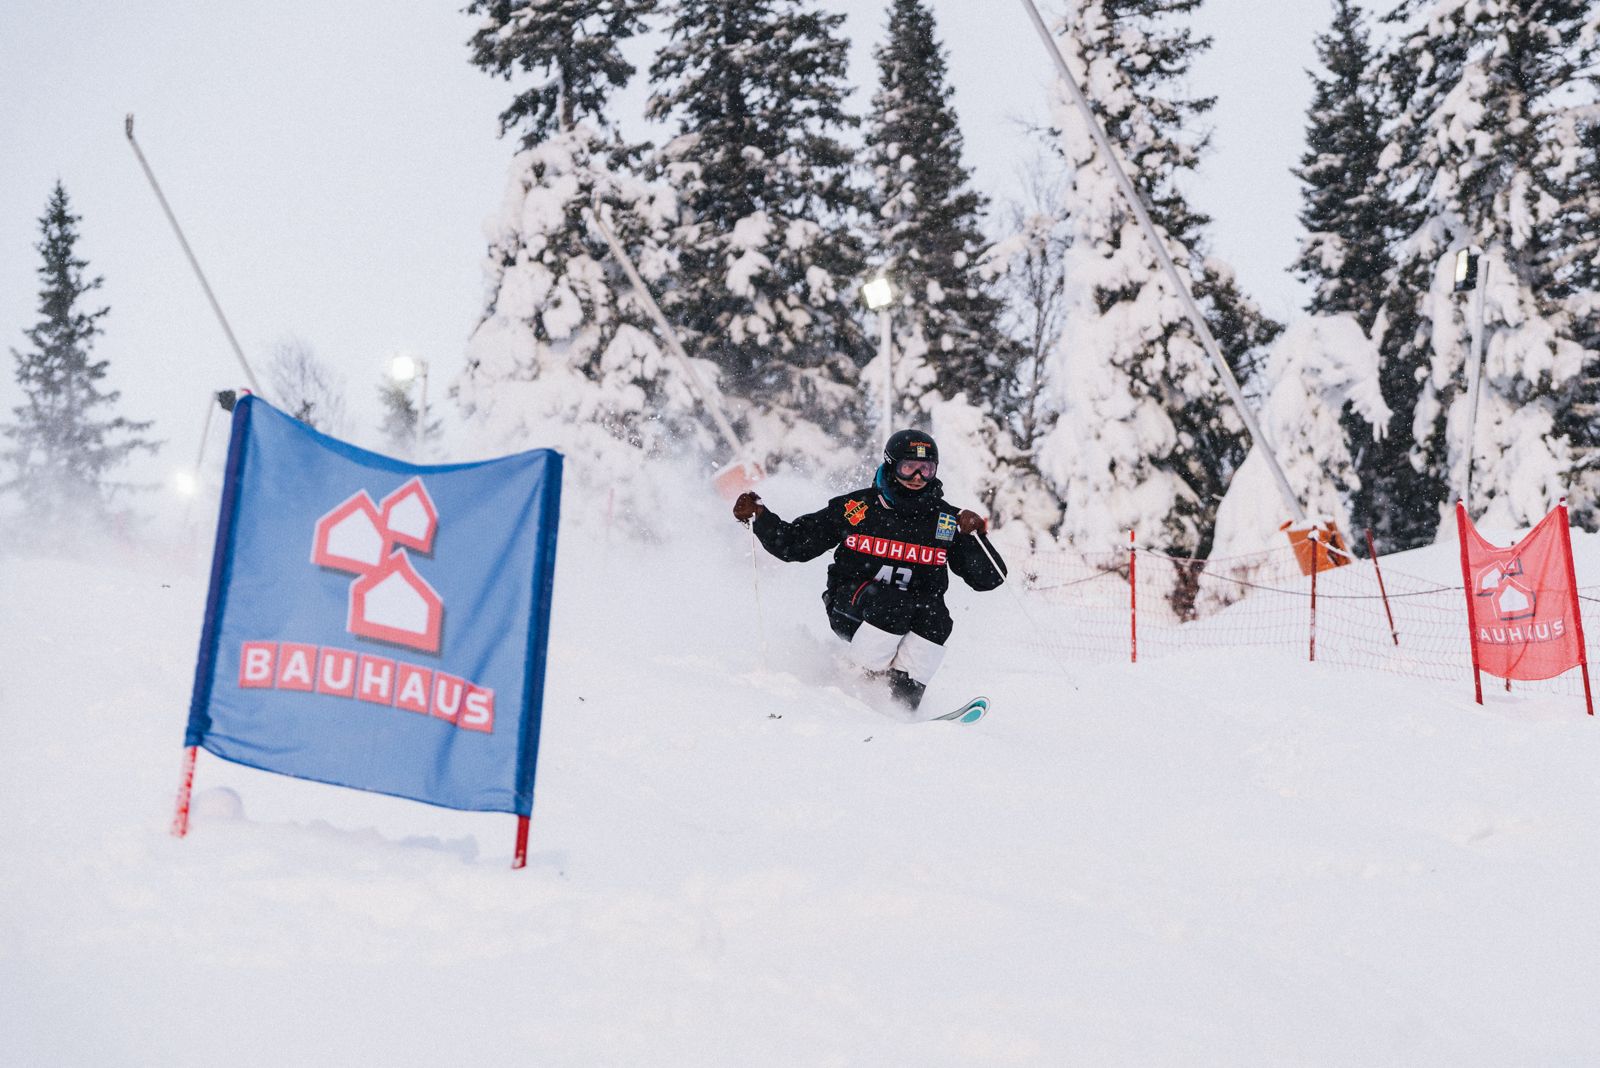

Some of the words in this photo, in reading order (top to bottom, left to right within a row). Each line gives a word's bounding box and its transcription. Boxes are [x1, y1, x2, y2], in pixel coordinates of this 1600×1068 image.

[847, 536, 947, 564] BAUHAUS
[873, 565, 913, 591] 43
[1480, 619, 1564, 643] AUHAUS
[245, 648, 490, 725] BAUHAUS
